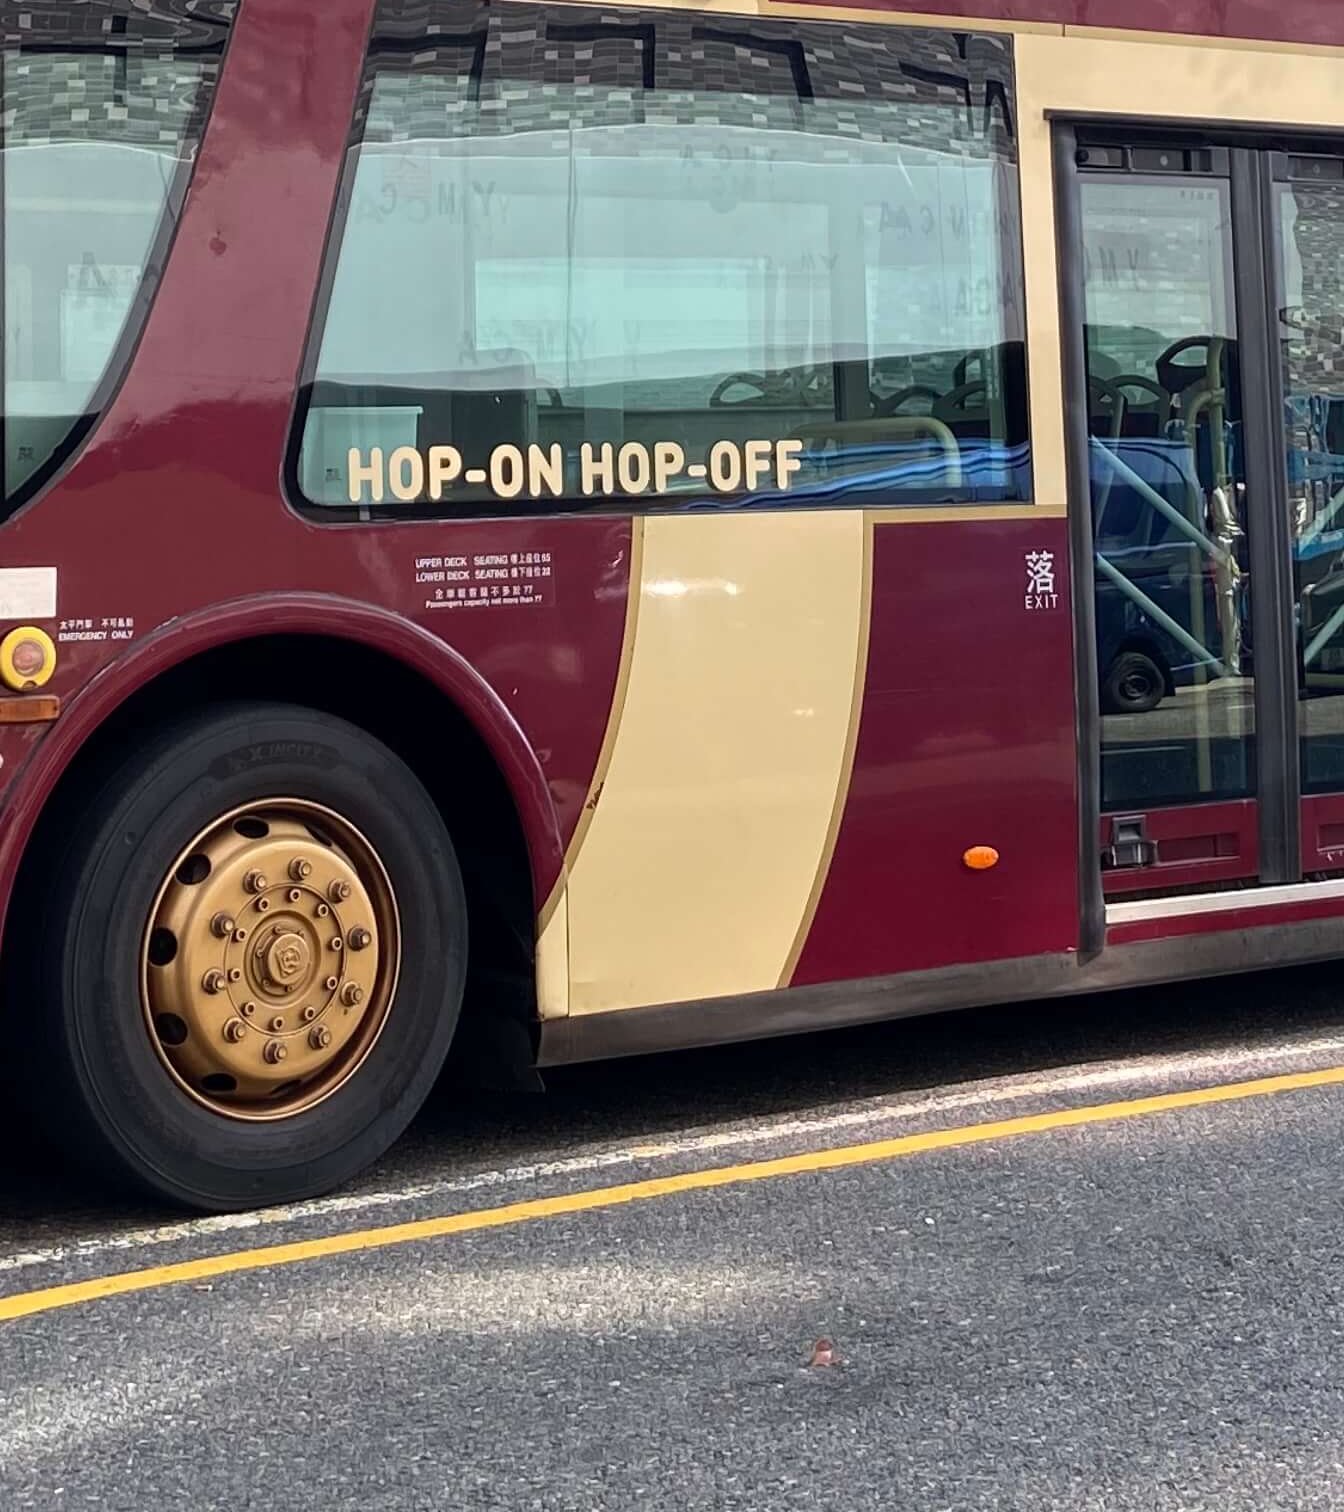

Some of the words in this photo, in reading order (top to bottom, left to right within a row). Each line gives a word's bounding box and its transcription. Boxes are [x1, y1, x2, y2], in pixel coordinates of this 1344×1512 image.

[348, 443, 564, 502] HOP-ON
[580, 439, 804, 496] HOP-OFF
[415, 557, 443, 569] UPPER
[444, 556, 467, 568] DECK
[473, 555, 508, 567] SEATING
[415, 571, 445, 583] LOWER
[447, 569, 470, 581] DECK
[474, 568, 509, 580] SEATING
[1025, 549, 1055, 594] 落
[1024, 593, 1059, 609] EXIT
[58, 631, 107, 641] EMERGENCY
[111, 630, 134, 640] ONLY
